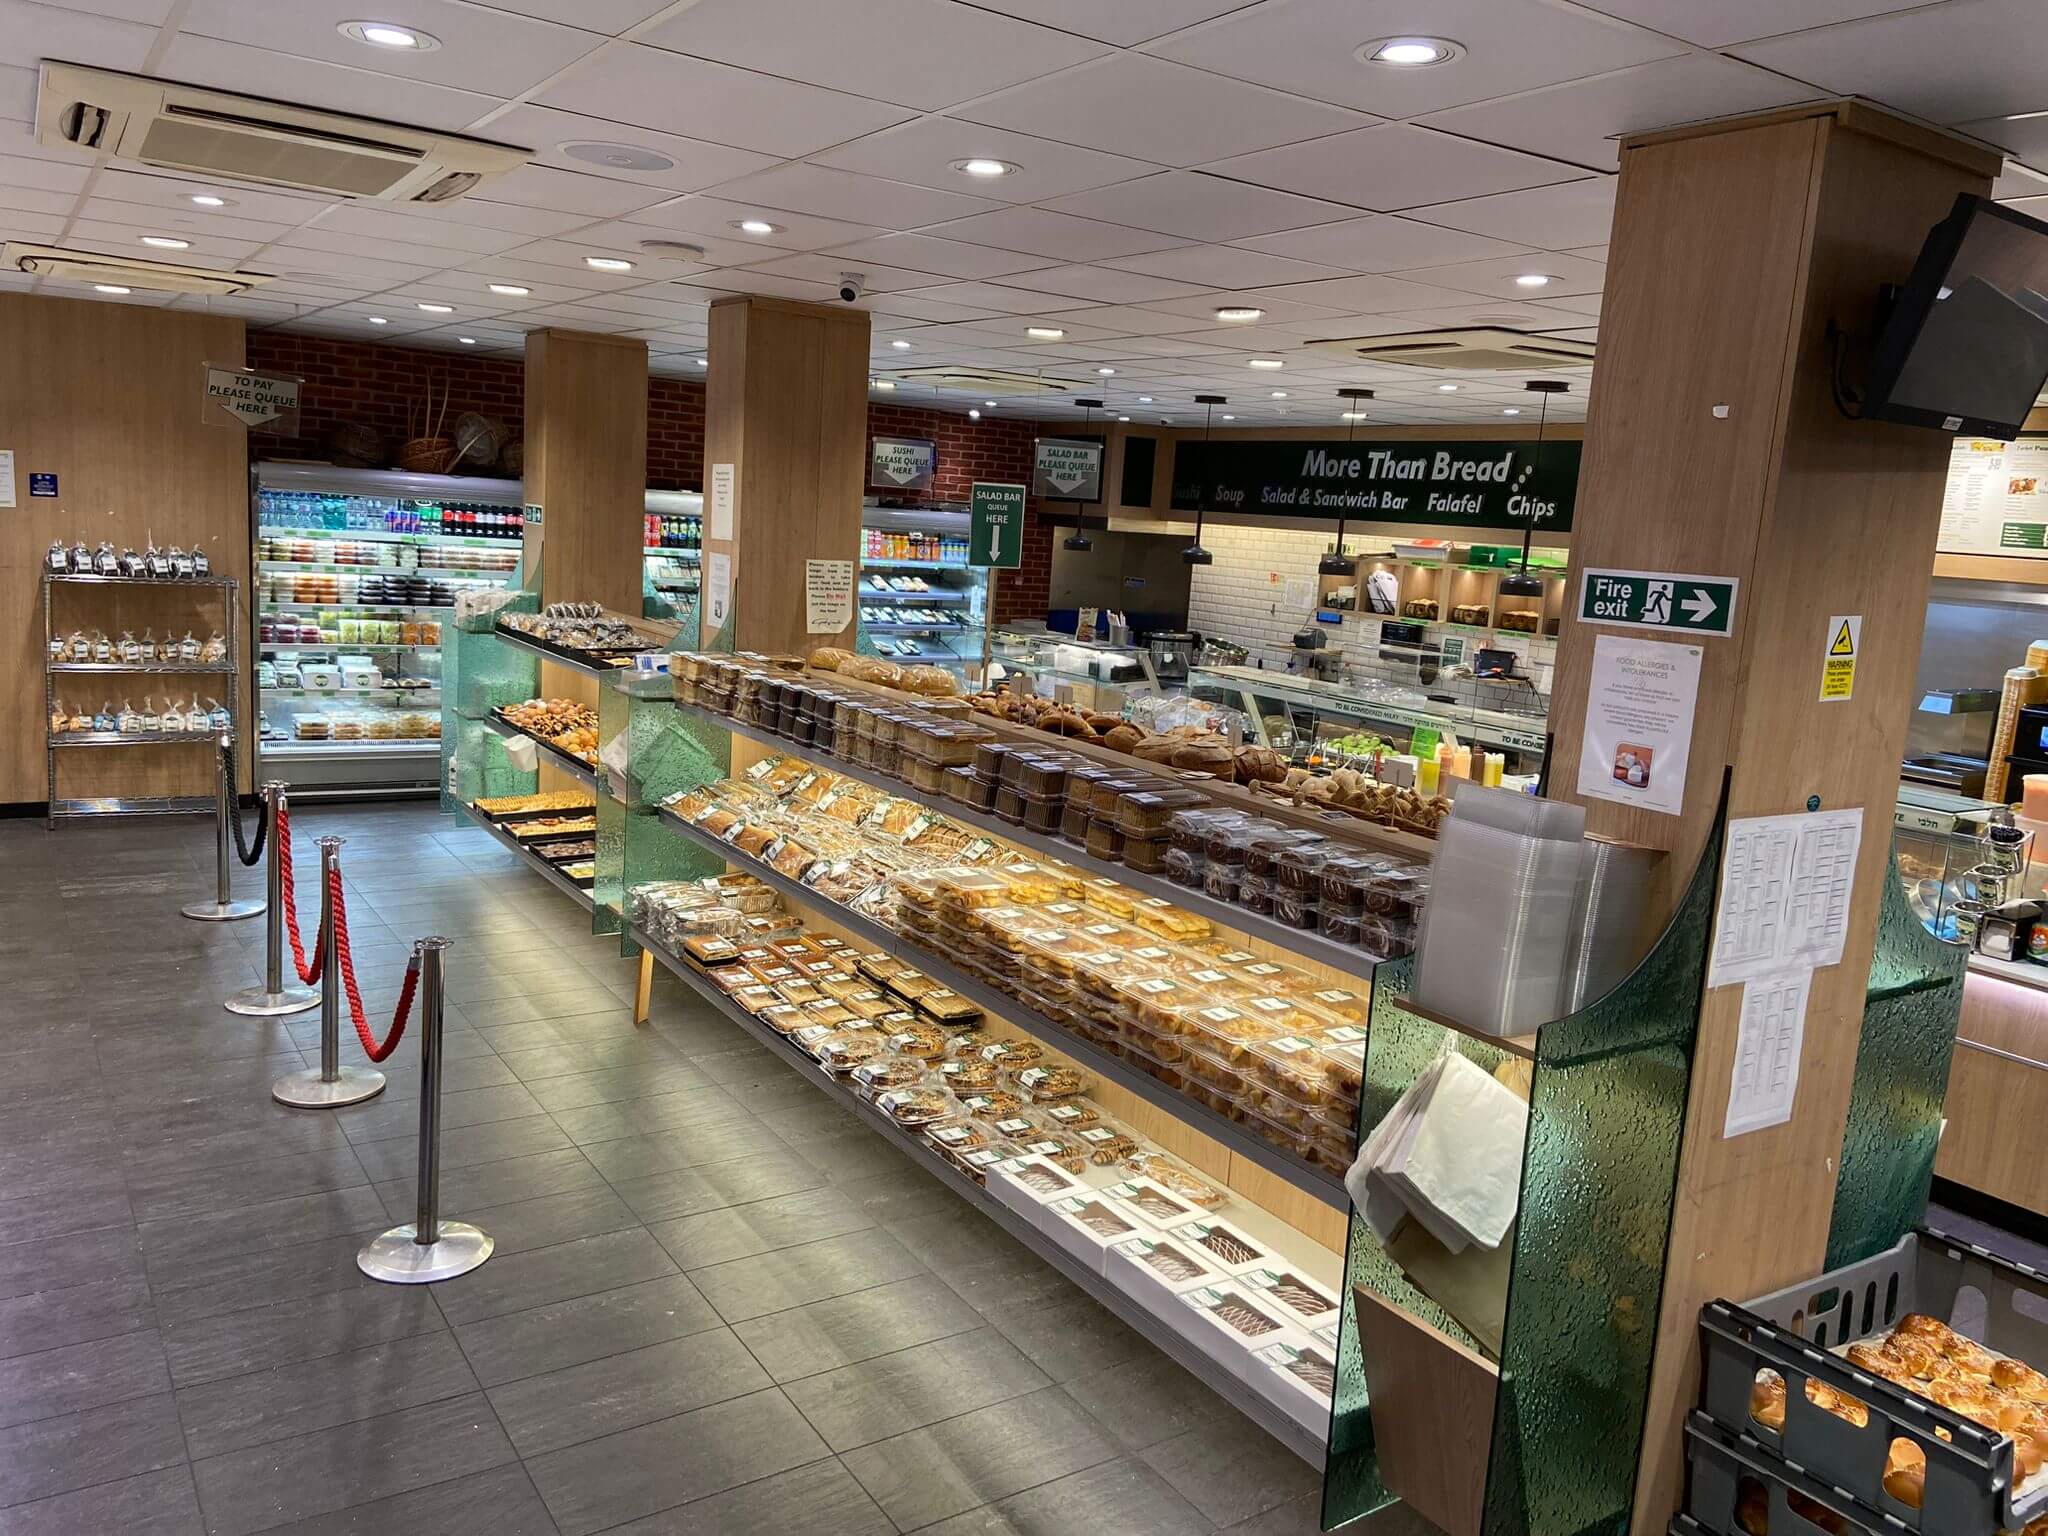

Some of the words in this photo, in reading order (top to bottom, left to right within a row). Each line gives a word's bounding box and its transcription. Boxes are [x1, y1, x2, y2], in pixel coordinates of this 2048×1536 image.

[234, 376, 250, 386] TO
[253, 380, 274, 390] PAY
[209, 385, 252, 400] PLEASE
[255, 392, 296, 407] QUEUE
[236, 401, 268, 415] HERE
[893, 446, 915, 455] SUSHI
[1047, 447, 1072, 459] SALAD
[1073, 451, 1089, 460] BAR
[876, 455, 902, 464] PLEASE
[1038, 459, 1067, 470] PLEASE
[1068, 462, 1096, 472] QUEUE
[1301, 449, 1361, 479] More
[1367, 451, 1427, 481] Than
[1431, 451, 1513, 483] Bread
[892, 466, 913, 475] HERE
[1055, 472, 1077, 481] HERE
[975, 490, 1002, 500] SALAD
[1004, 492, 1021, 502] BAR
[987, 503, 1009, 511] QUEUE
[1215, 484, 1244, 507] Soup
[1261, 486, 1297, 504] Salad
[1299, 488, 1310, 505] &
[1313, 488, 1377, 509] Sandwich
[1381, 490, 1409, 511] Bar
[1426, 492, 1483, 515] Falafel
[1507, 495, 1555, 522] Chips
[985, 514, 1009, 524] HERE
[1595, 578, 1633, 599] Fire
[1593, 599, 1629, 618] exit
[1335, 702, 1343, 710] TO
[1350, 705, 1382, 718] CONSIDERED
[1502, 735, 1511, 743] TO
[1512, 737, 1521, 745] BE
